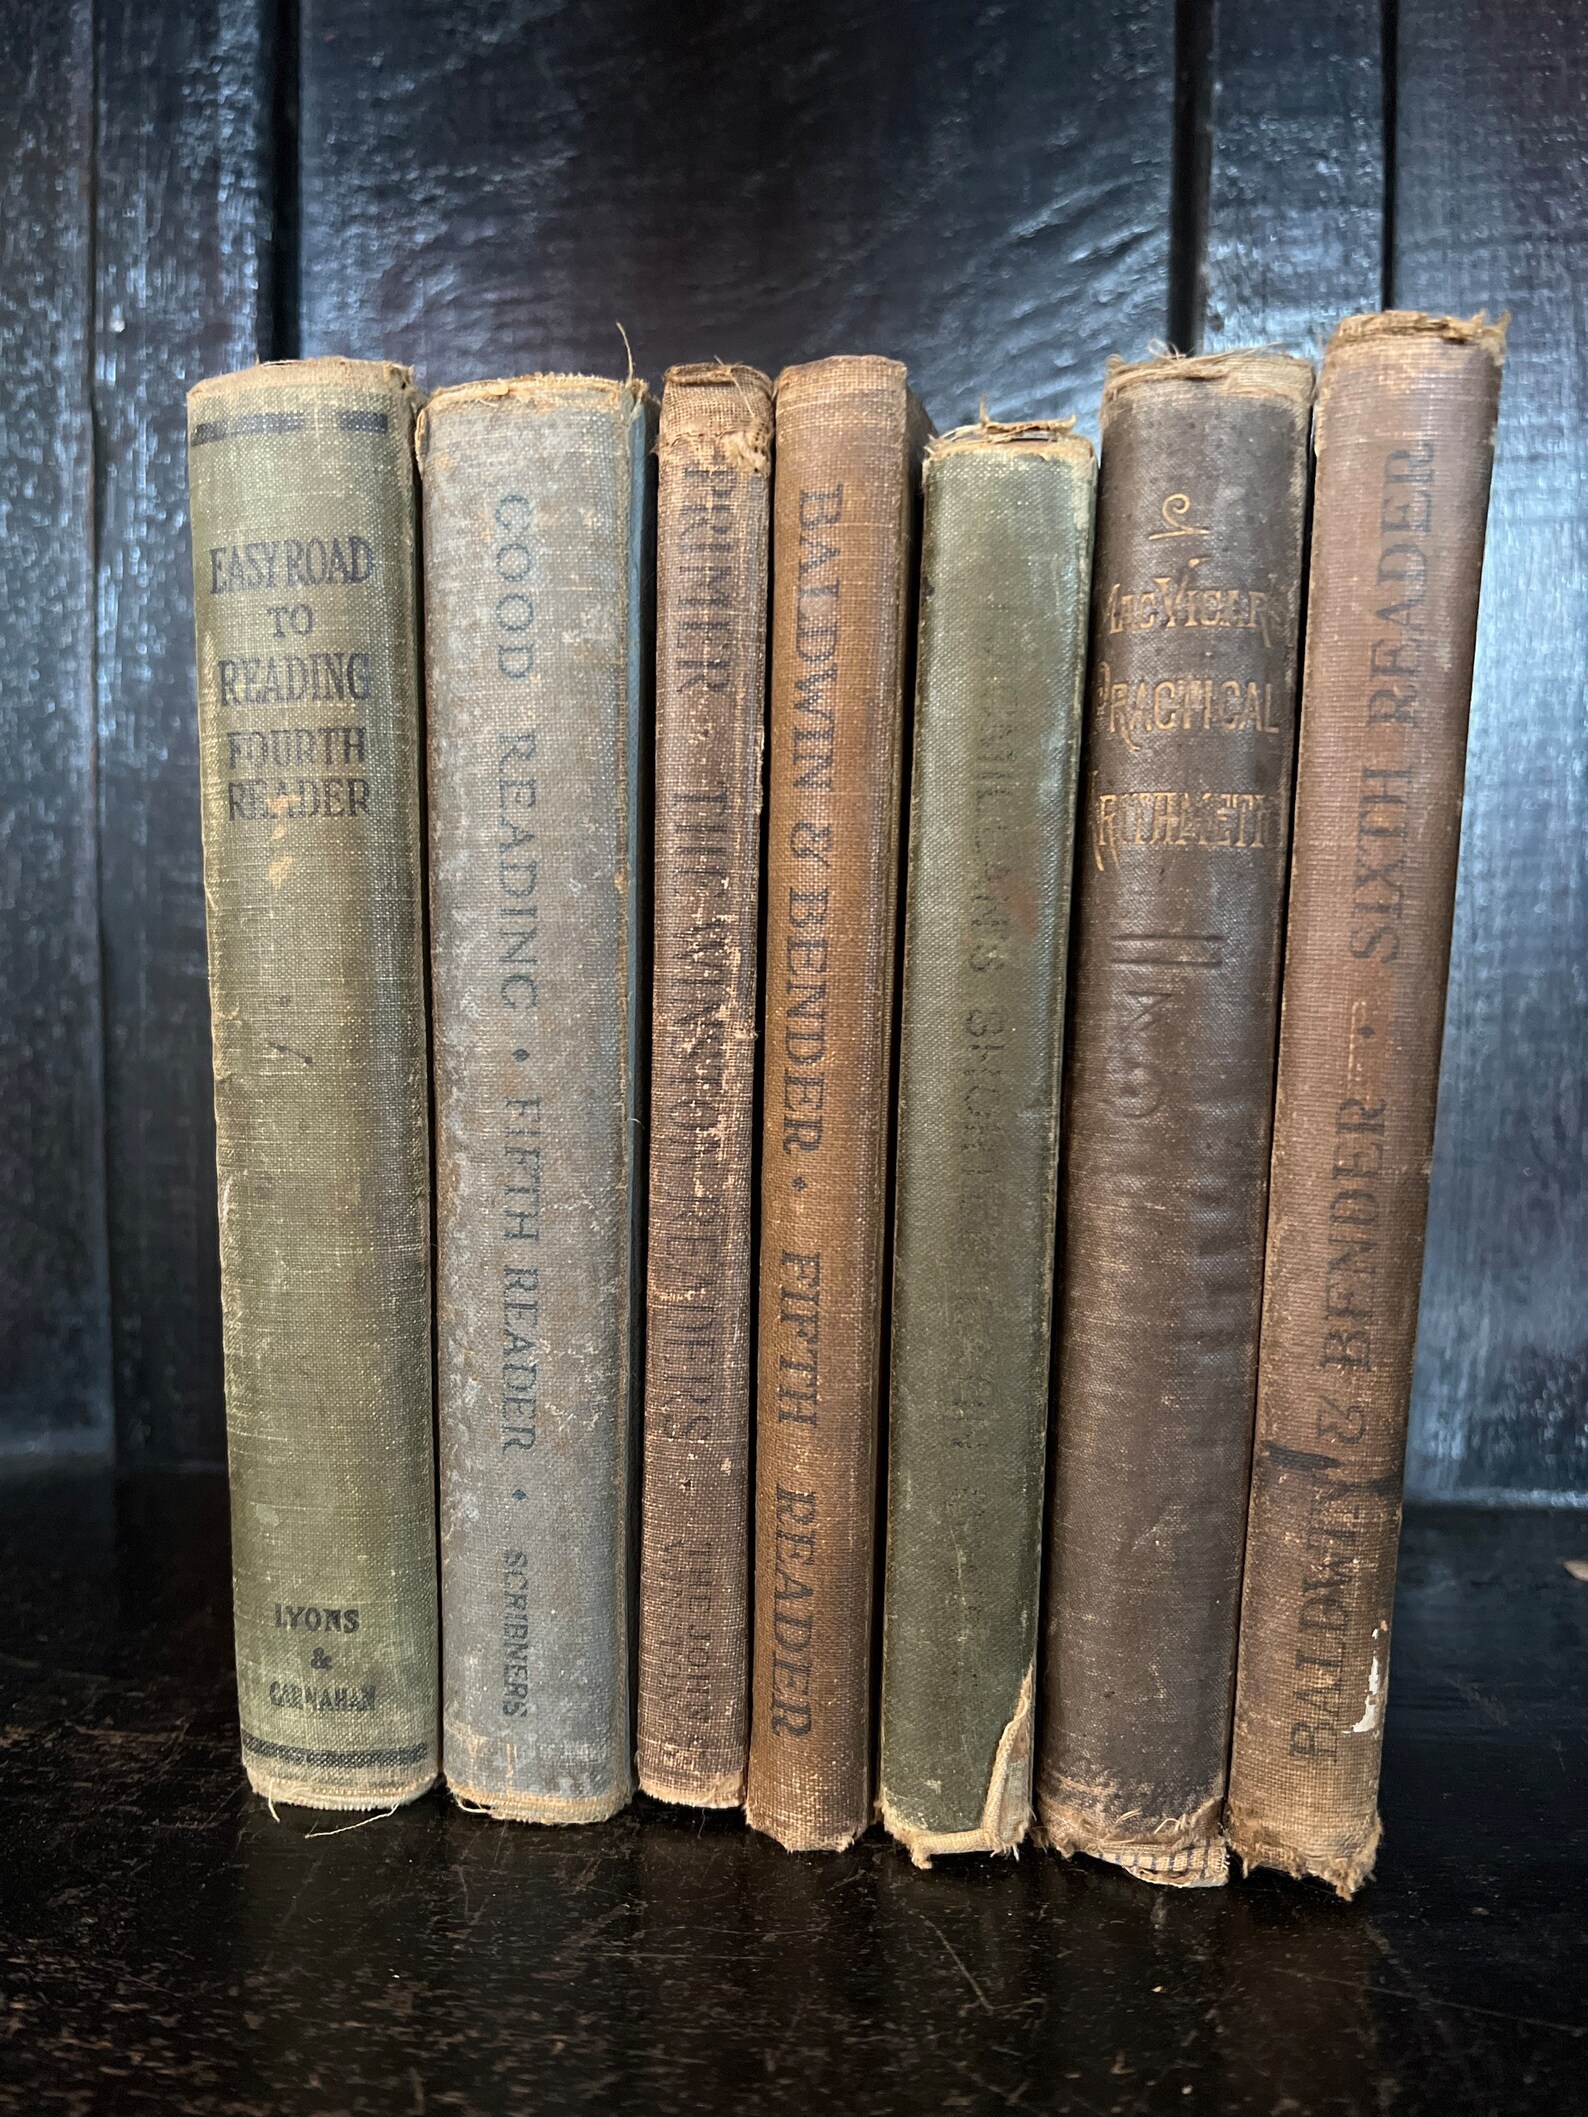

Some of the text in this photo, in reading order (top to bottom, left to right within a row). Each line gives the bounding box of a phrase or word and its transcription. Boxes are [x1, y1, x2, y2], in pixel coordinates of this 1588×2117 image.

[209, 535, 375, 594] EASY ROAD
[267, 603, 314, 639] TO
[496, 493, 535, 680] GOOD
[676, 464, 738, 696] PRIMER
[1365, 442, 1436, 729] READER
[218, 652, 370, 707] READING
[227, 727, 368, 770] FOURTH
[1096, 661, 1280, 751] PRACTICAL
[228, 777, 372, 822] READER
[499, 732, 538, 1012] READING
[1349, 766, 1415, 966] SIXTH
[503, 1097, 541, 1242] FIFTH
[771, 483, 845, 1738] BALDWIN & BENDER FIFTH READER
[1319, 1096, 1388, 1374] BENDER
[501, 1267, 541, 1454] READER
[274, 1603, 360, 1634] LYONS
[310, 1646, 334, 1671] &
